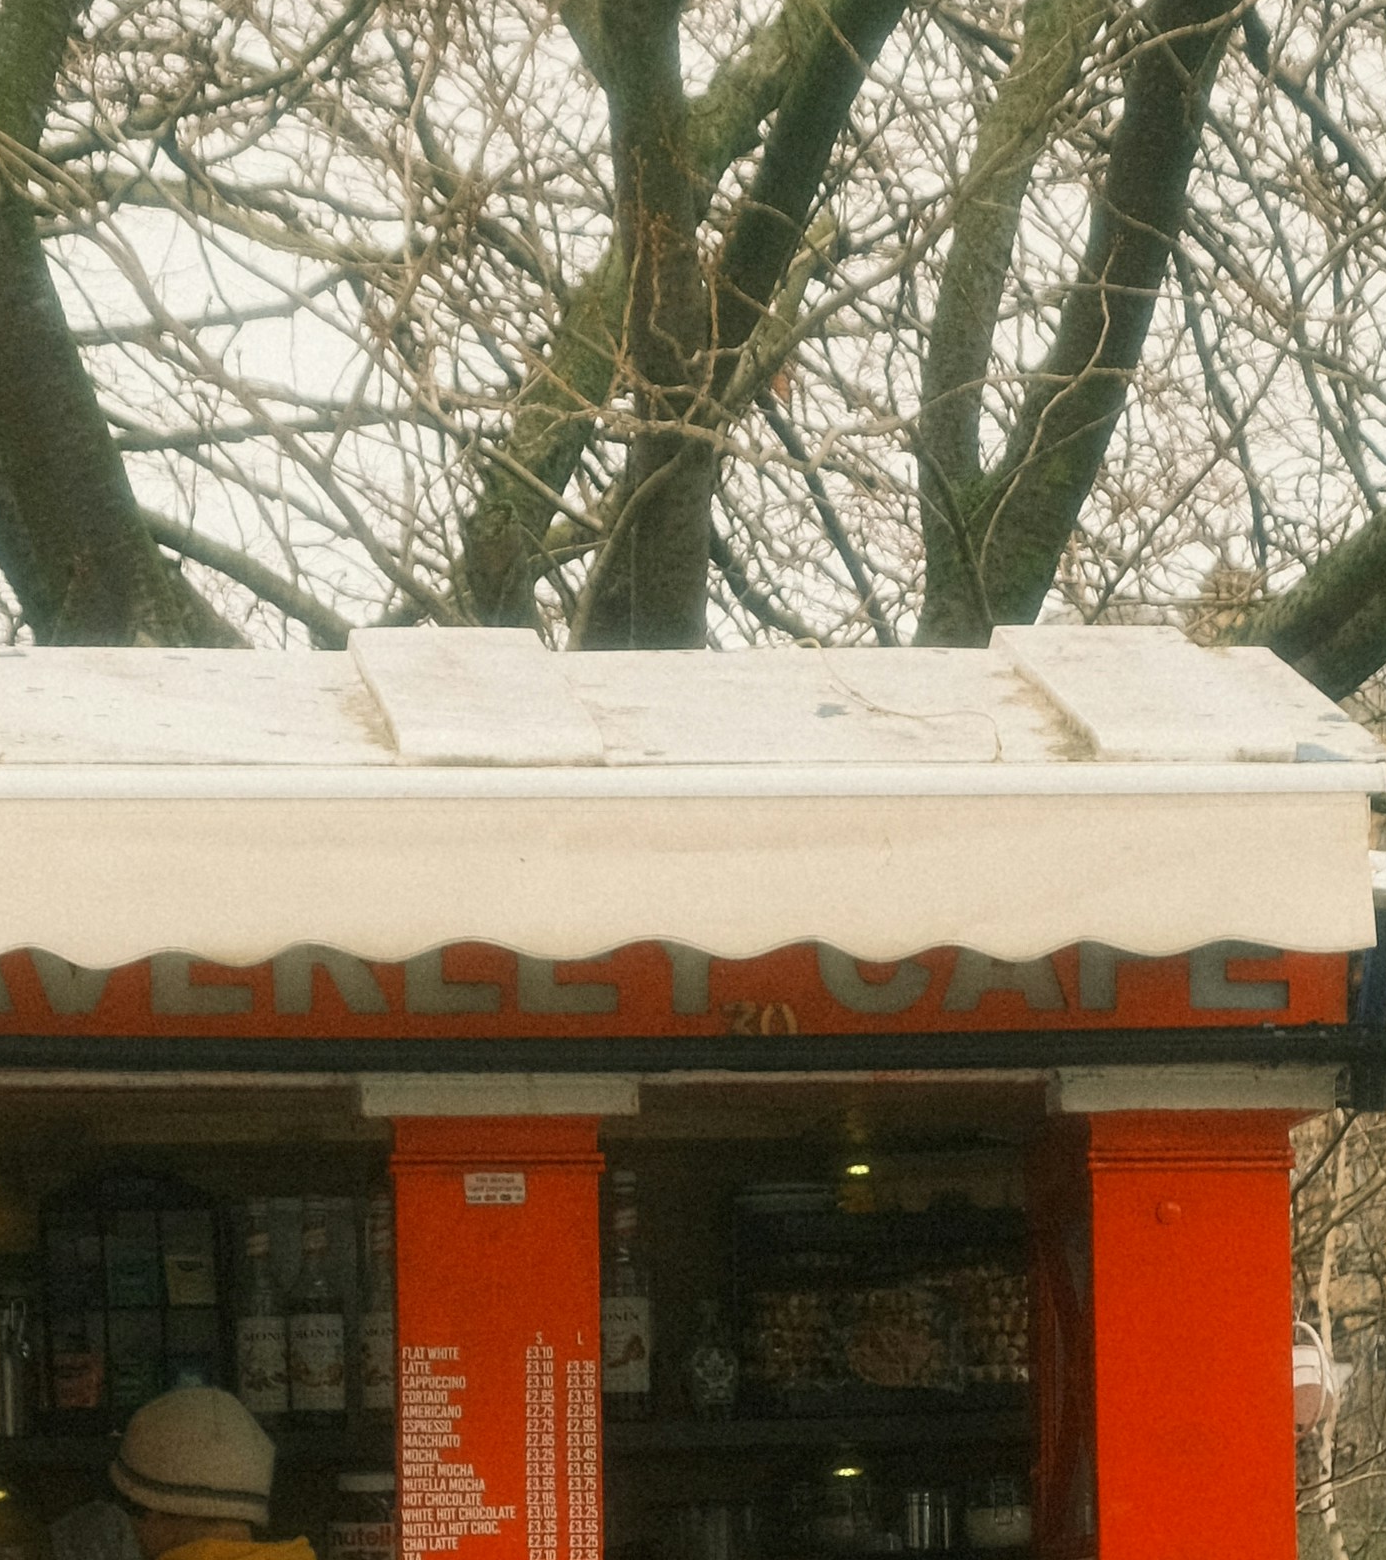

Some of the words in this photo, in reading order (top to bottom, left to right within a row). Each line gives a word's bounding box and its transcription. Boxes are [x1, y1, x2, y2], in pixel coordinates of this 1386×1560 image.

[536, 1331, 542, 1344] S
[577, 1331, 583, 1345] L
[402, 1346, 425, 1360] FLAT
[428, 1347, 460, 1360] WHITE
[526, 1346, 553, 1359] £3.10
[402, 1361, 431, 1374] LATTE
[526, 1361, 553, 1373] £3.10
[567, 1361, 595, 1374] £3.35
[402, 1376, 466, 1389] CAPPUCCINO
[526, 1376, 554, 1388] £3.10
[567, 1375, 595, 1388] £3.35
[402, 1391, 448, 1404] CORTADO
[402, 1405, 462, 1419] AMERICANO
[526, 1405, 554, 1418] £2.75
[567, 1405, 596, 1418] £2.95
[402, 1420, 452, 1433] ESPRESSO
[526, 1420, 554, 1432] £2.75
[567, 1420, 596, 1433] £2.95
[402, 1434, 460, 1448] MACCHIATO
[402, 1464, 434, 1477] WHITE
[438, 1464, 474, 1477] MOCHA
[402, 1479, 446, 1492] NUTELLA
[449, 1479, 485, 1491] MOCHA
[403, 1494, 423, 1507] HOT
[425, 1493, 482, 1506] CHOCOLATE
[402, 1508, 434, 1522] WHITE
[436, 1507, 457, 1521] HOT
[459, 1506, 516, 1520] CHOCOLATE
[402, 1523, 446, 1536] NUTELLA
[449, 1522, 468, 1535] HOT
[403, 1538, 428, 1551] CHAI
[430, 1537, 458, 1550] LATTE
